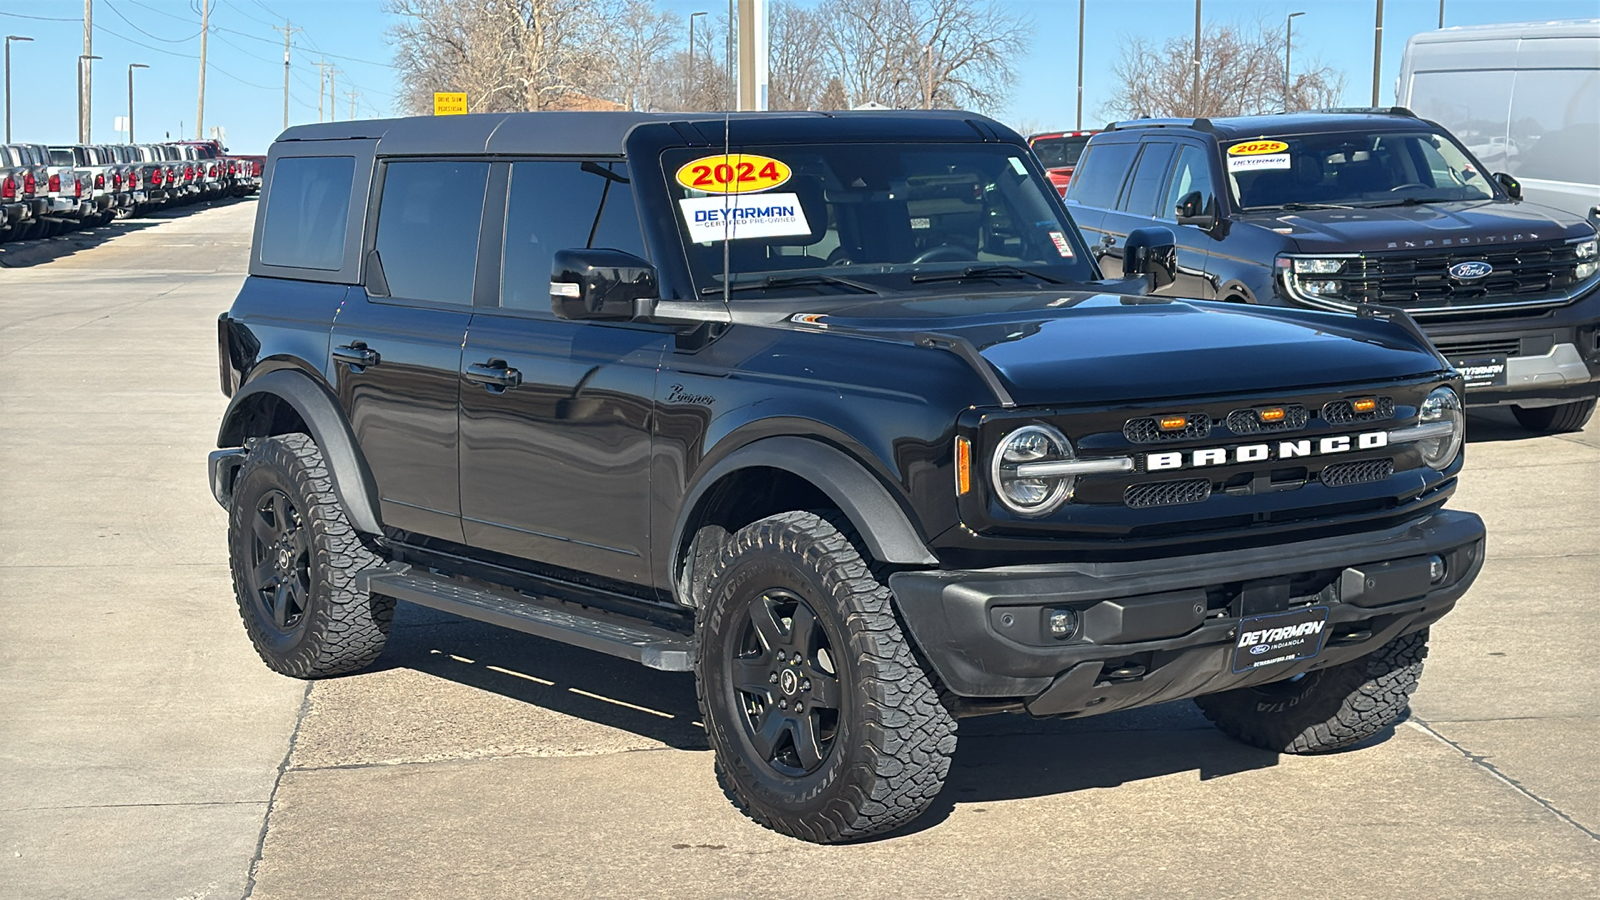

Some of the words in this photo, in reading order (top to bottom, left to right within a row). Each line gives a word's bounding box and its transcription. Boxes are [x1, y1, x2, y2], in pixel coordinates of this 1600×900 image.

[1234, 142, 1281, 154] 2025
[692, 161, 780, 186] 2024
[694, 205, 795, 223] DEYARMAN
[749, 216, 796, 225] PRE-OWNED
[1386, 232, 1540, 249] EXPEDITION
[1457, 264, 1485, 277] Ford
[1147, 431, 1389, 471] BRONCO
[1237, 620, 1326, 648] DEYARMAN
[1270, 638, 1305, 651] INDIANOLA
